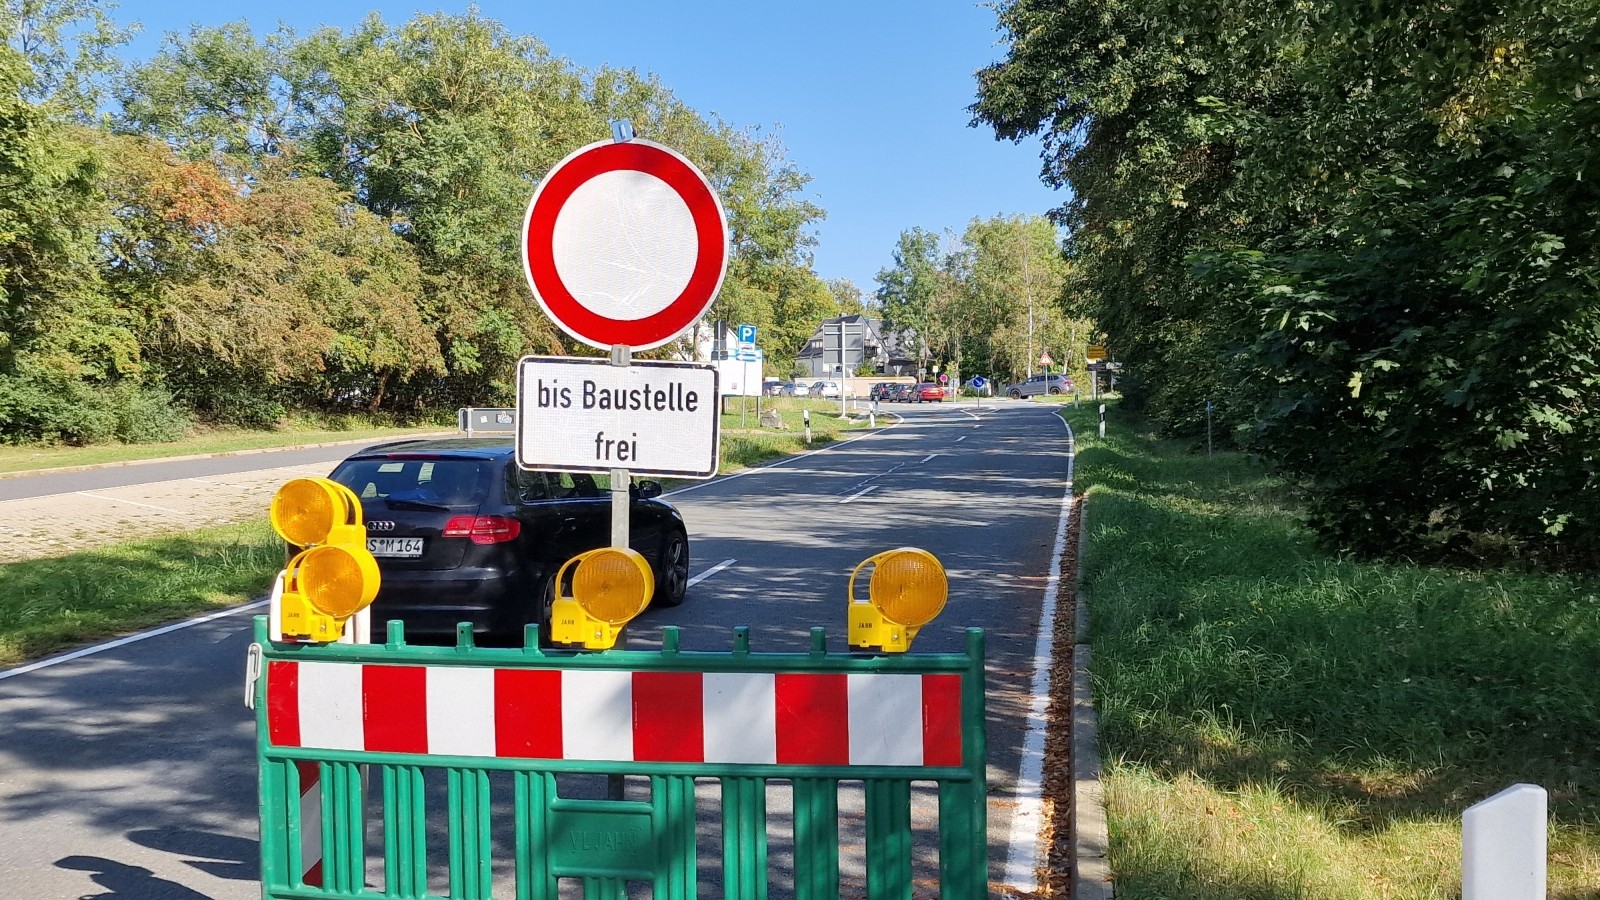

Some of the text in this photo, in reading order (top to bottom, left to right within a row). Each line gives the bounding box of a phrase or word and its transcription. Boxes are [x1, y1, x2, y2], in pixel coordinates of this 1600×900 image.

[742, 327, 753, 341] P
[538, 379, 698, 412] bis Baustelle
[595, 431, 637, 461] frei
